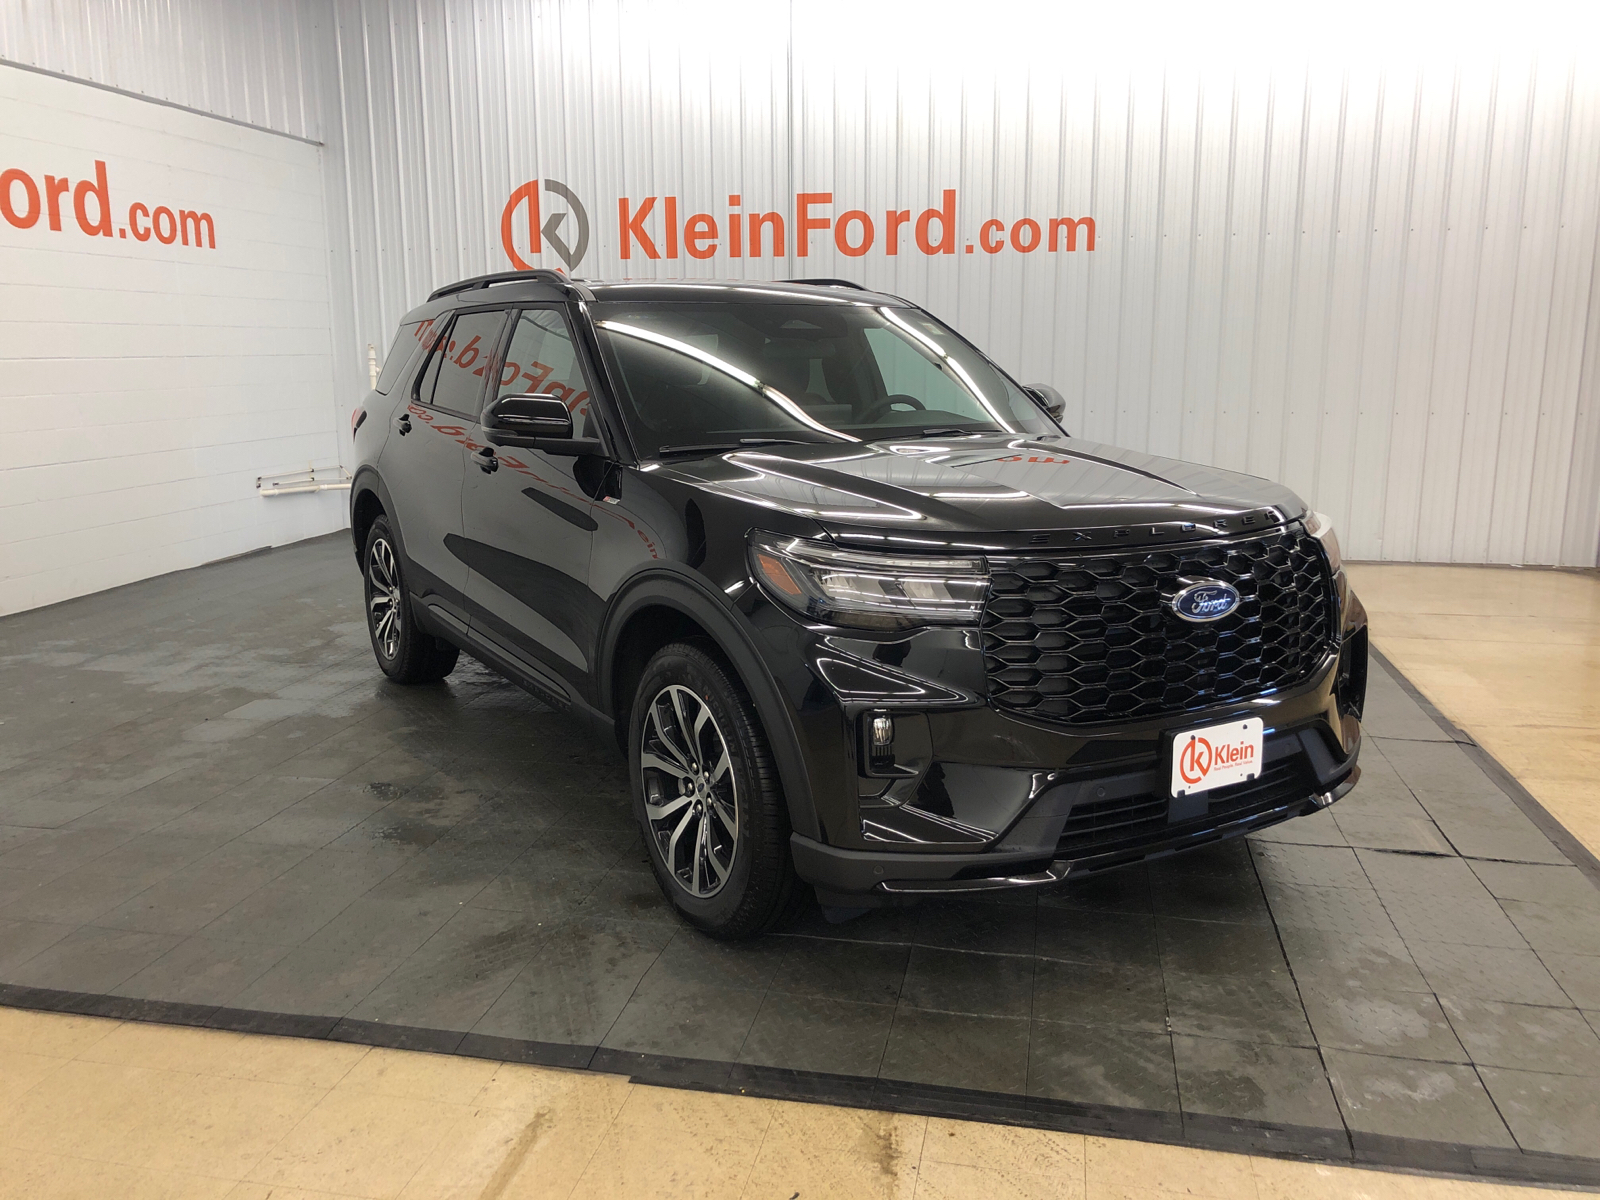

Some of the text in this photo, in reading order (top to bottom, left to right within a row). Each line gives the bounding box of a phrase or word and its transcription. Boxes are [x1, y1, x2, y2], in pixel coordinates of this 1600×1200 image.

[618, 188, 1096, 260] KleinFord.com
[1028, 511, 1280, 544] EXPLORER
[1191, 590, 1231, 614] Ford
[1214, 741, 1254, 765] Klein
